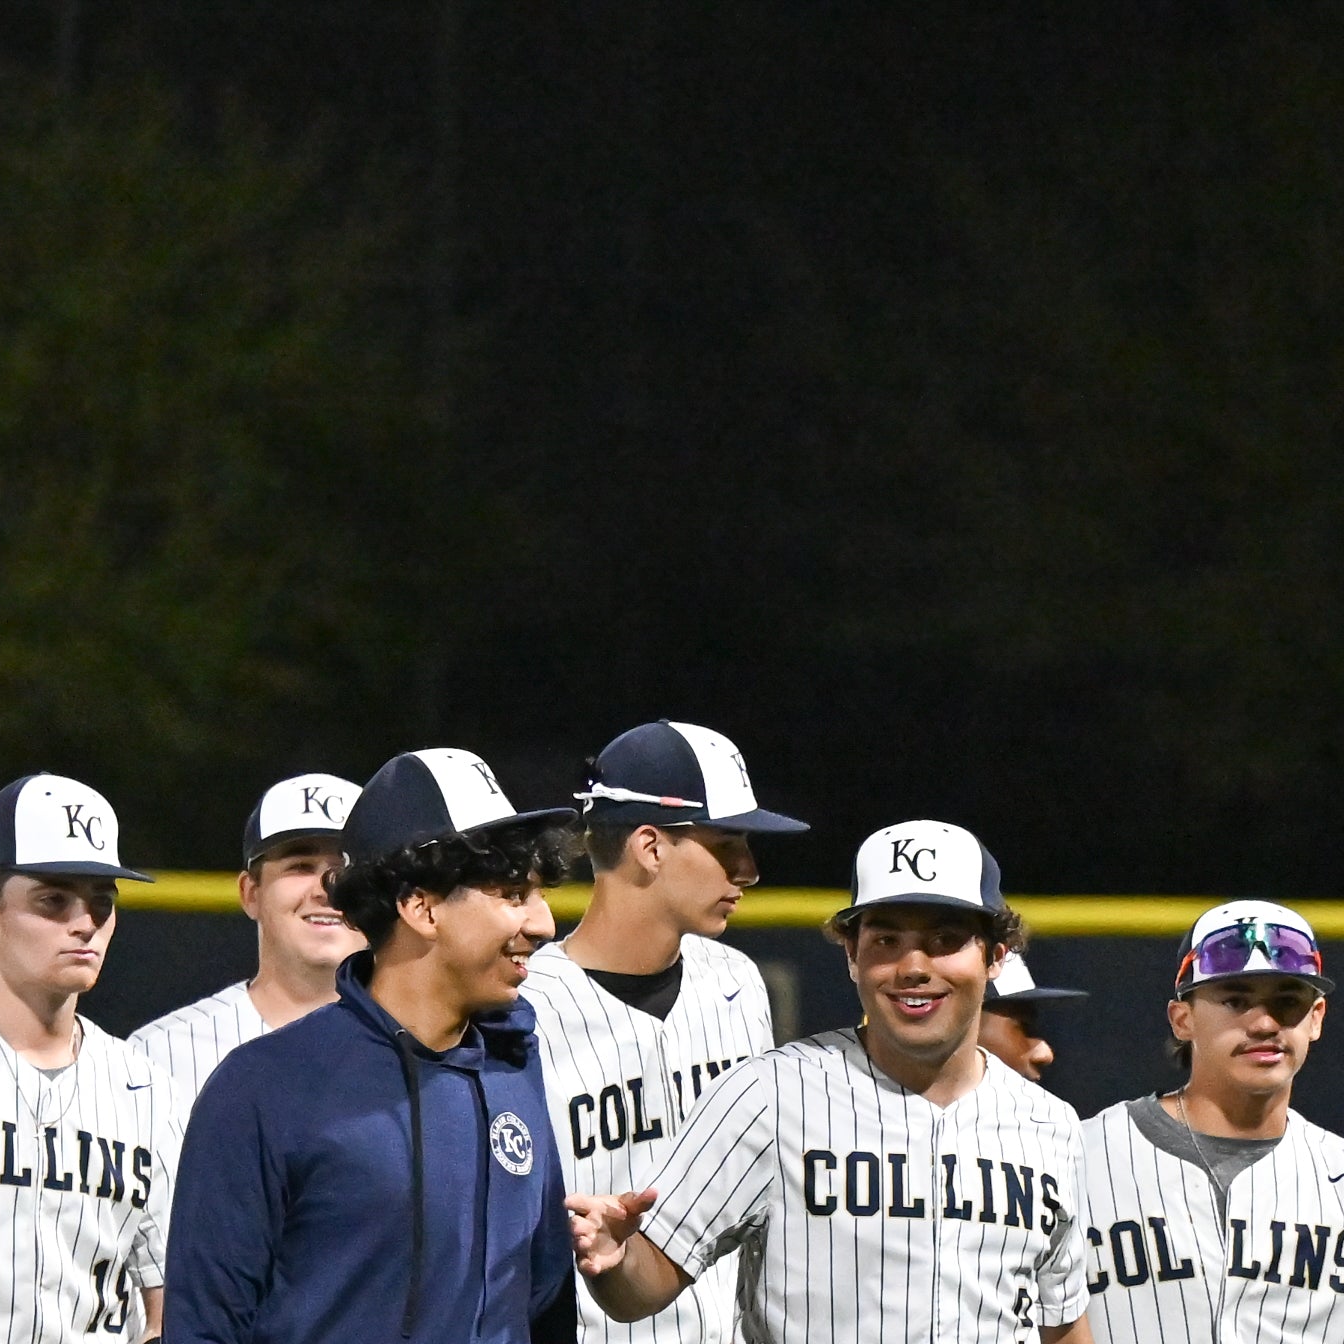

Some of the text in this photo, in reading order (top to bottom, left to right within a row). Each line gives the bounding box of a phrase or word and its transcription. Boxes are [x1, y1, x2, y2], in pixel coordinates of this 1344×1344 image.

[61, 804, 105, 851] KC
[300, 787, 345, 824] KC
[889, 838, 936, 882] KC
[501, 1128, 526, 1160] KC
[803, 1149, 1061, 1236] COLLINS
